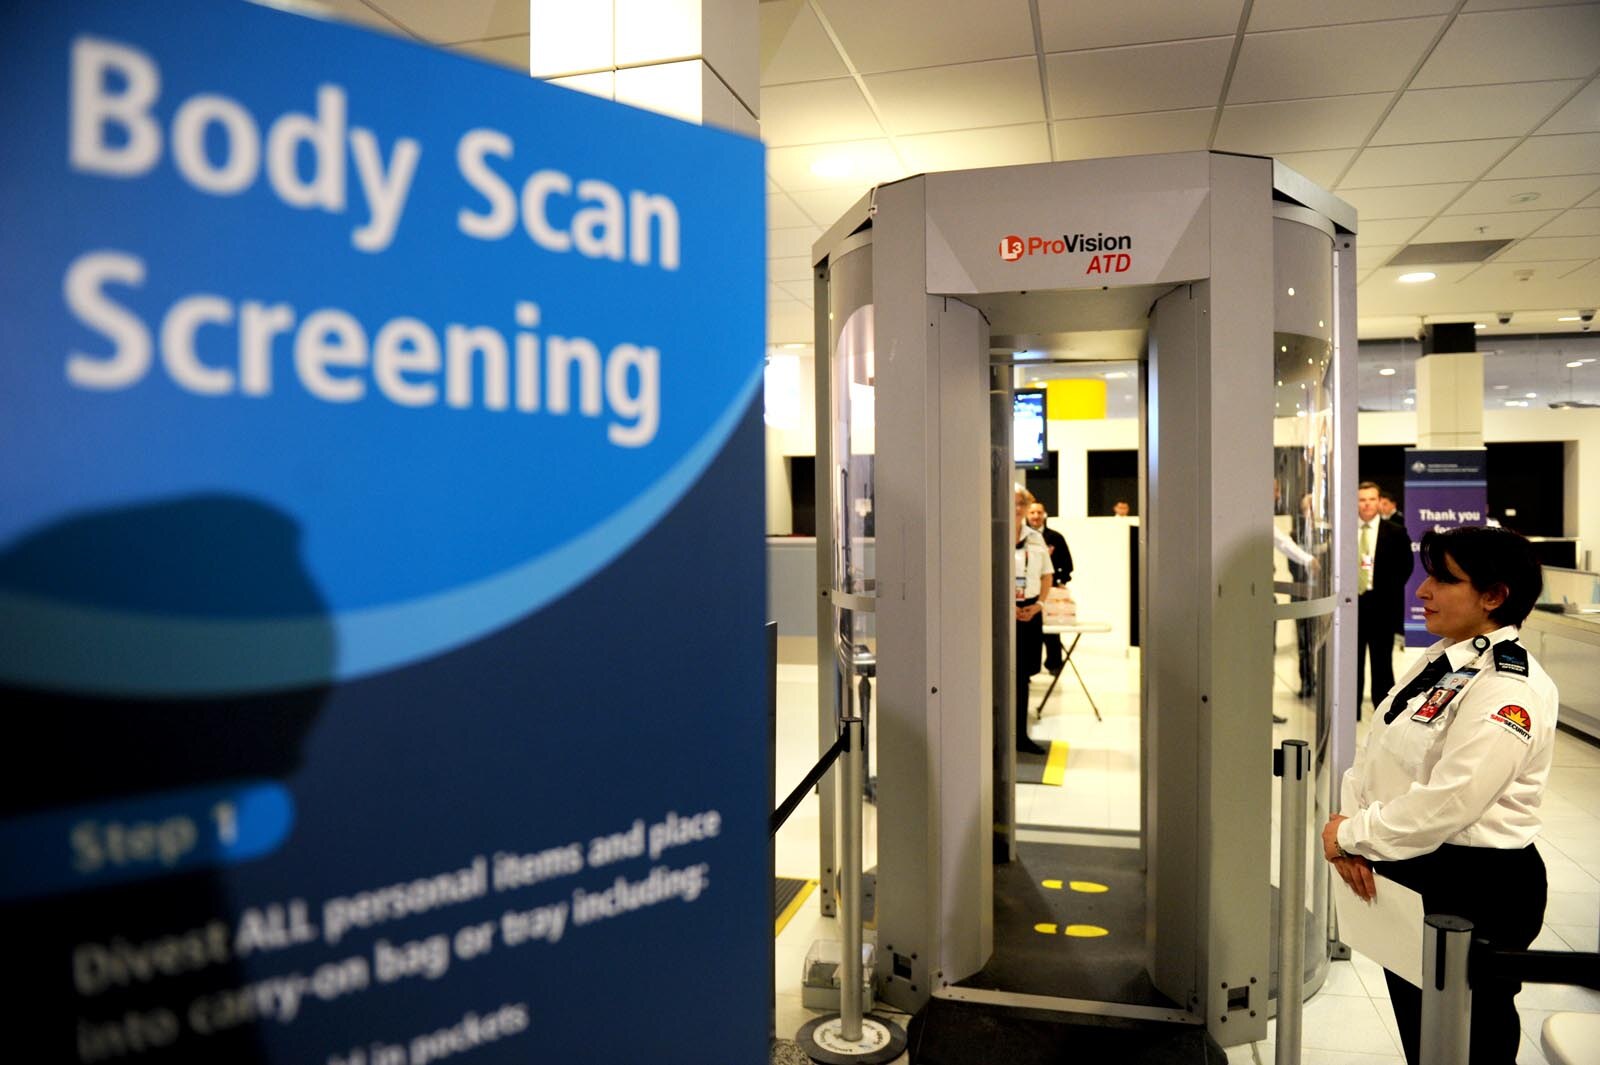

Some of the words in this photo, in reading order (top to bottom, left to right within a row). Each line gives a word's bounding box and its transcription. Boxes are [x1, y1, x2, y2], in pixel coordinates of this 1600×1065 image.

[68, 34, 421, 254] Body
[455, 128, 682, 271] Scan
[1028, 233, 1133, 256] ProVision
[1086, 253, 1132, 275] ATD
[63, 250, 662, 448] Screening
[1418, 508, 1456, 522] Thank
[1458, 510, 1481, 525] you
[69, 814, 199, 874] Step
[211, 800, 239, 848] 1
[72, 918, 231, 998] Divest
[233, 896, 318, 957] ALL
[324, 857, 488, 943] personal
[494, 839, 585, 890] items
[588, 820, 645, 868] and
[649, 808, 721, 857] place
[75, 1003, 182, 1065] into
[187, 952, 370, 1037] carry-on
[374, 931, 450, 986] bag
[454, 918, 497, 961] or
[502, 898, 568, 945] tray
[573, 863, 709, 924] including:
[410, 1001, 530, 1065] pockets
